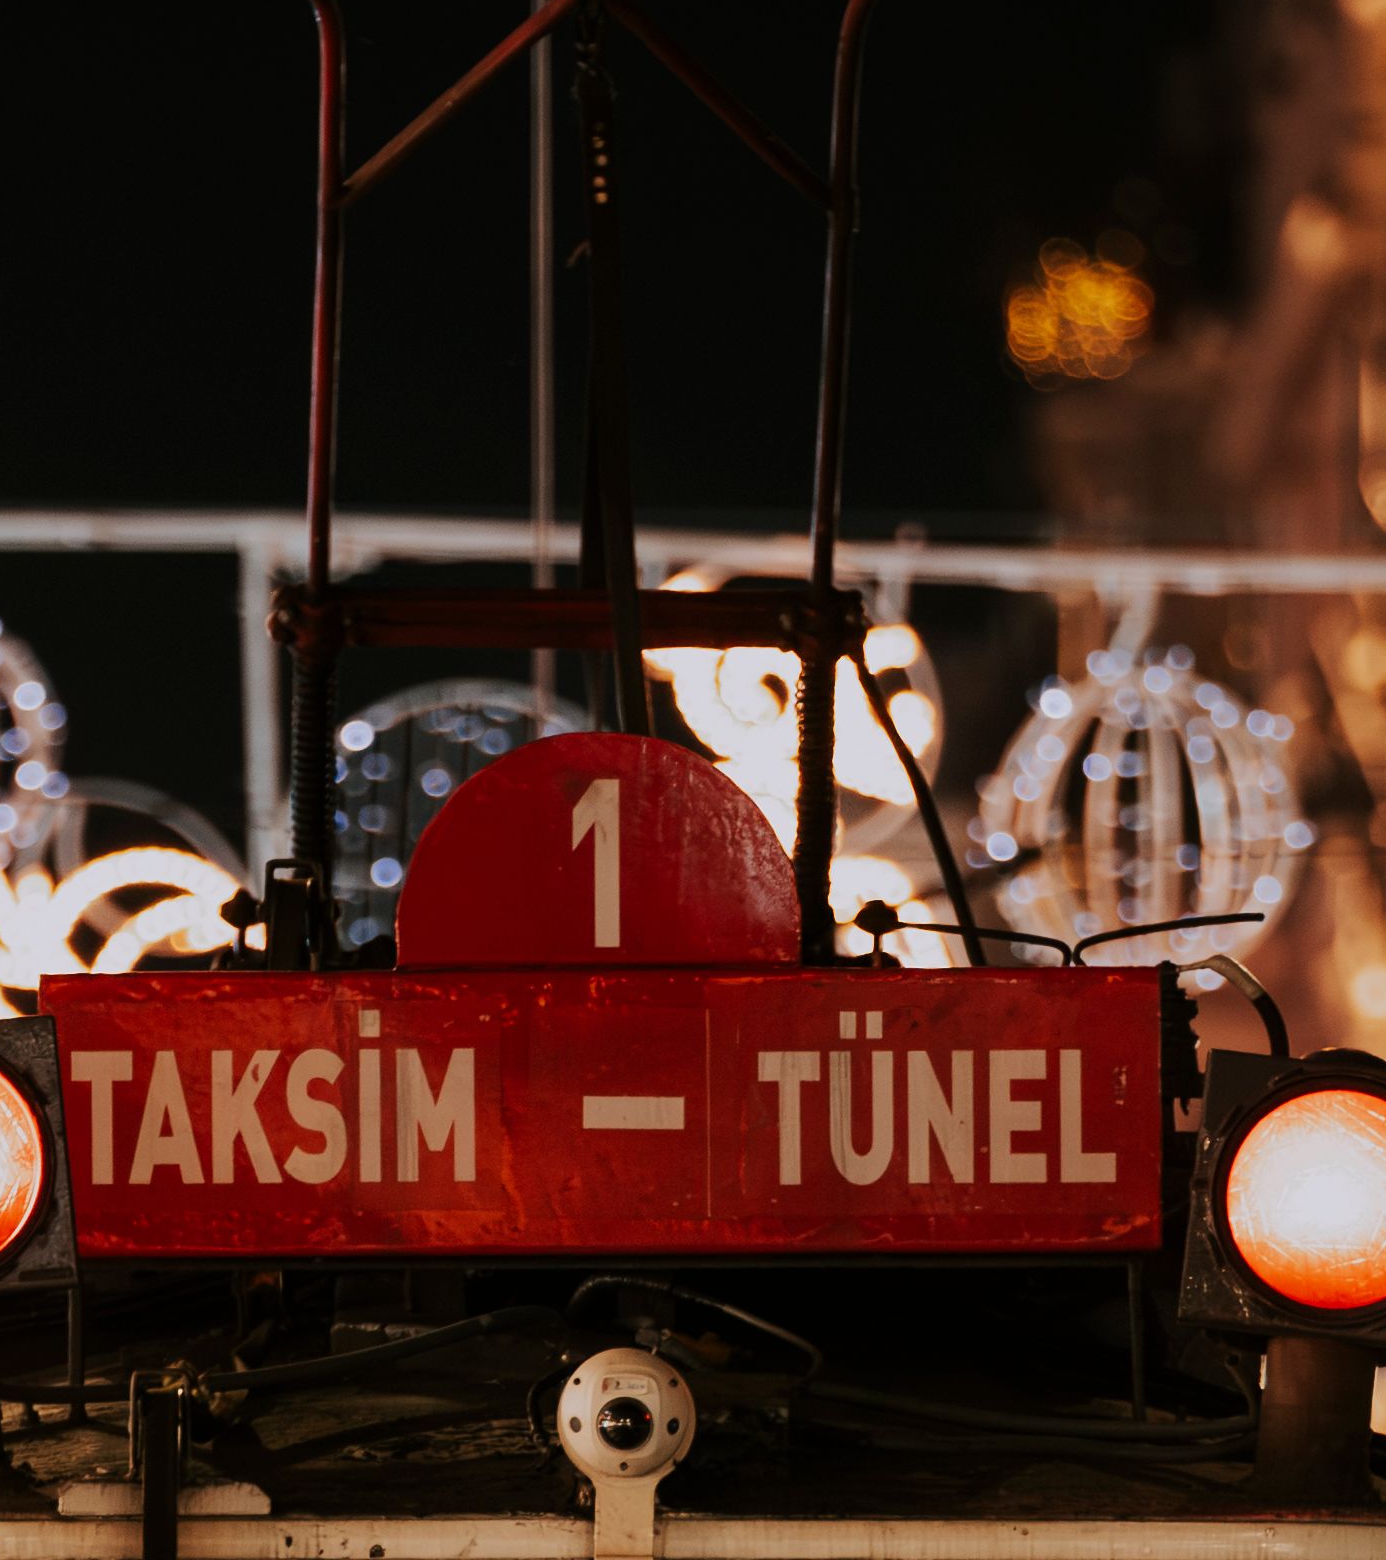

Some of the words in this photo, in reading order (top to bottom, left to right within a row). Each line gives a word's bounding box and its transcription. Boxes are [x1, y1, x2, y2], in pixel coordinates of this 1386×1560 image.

[572, 778, 620, 947] 1
[70, 1009, 476, 1185] TAKSİM
[757, 1010, 1117, 1186] TÜNEL
